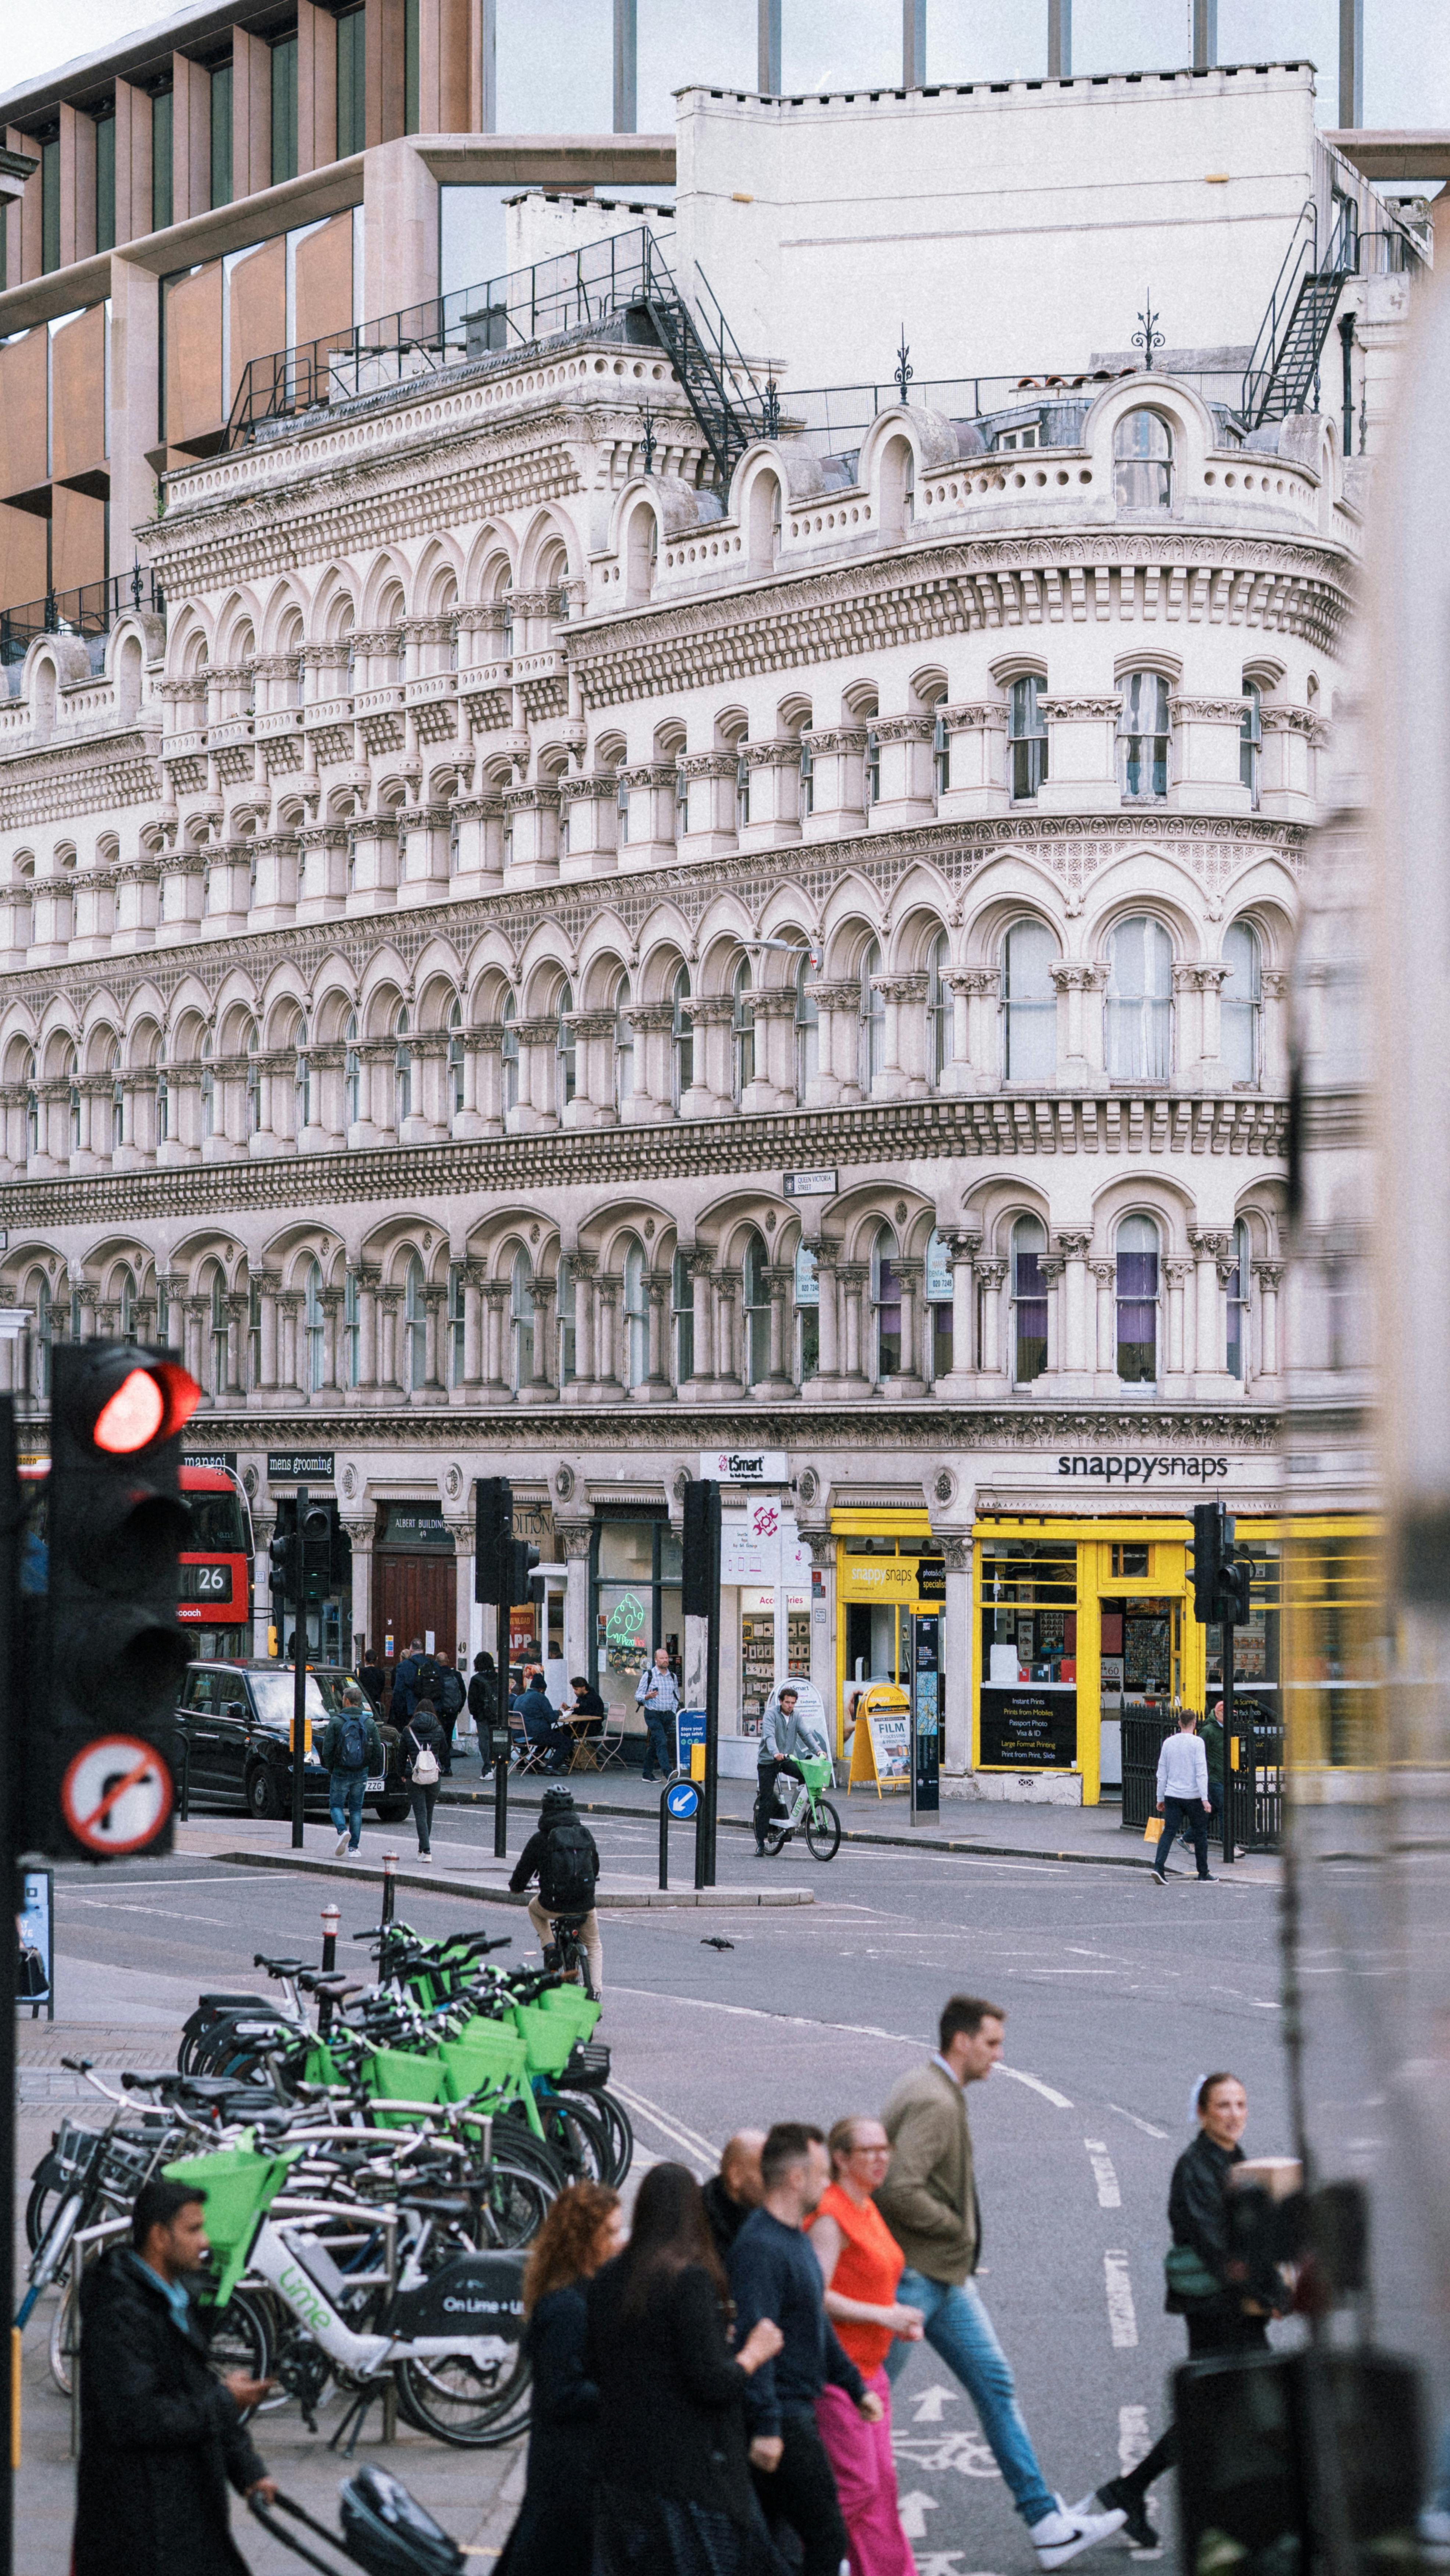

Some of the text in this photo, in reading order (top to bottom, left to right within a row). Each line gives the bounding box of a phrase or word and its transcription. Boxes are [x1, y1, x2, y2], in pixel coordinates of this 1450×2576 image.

[270, 1456, 332, 1473] mens grooming
[1058, 1456, 1228, 1483] snappysnaps
[395, 1518, 446, 1528] ALBERT BUILDING
[199, 1568, 224, 1589] 26
[852, 1568, 911, 1586] snappysnaps
[458, 1642, 467, 1653] 49
[879, 1723, 904, 1733] FILM
[1001, 1740, 1015, 1748] Large
[1036, 1741, 1056, 1750] Printing
[792, 1797, 804, 1817] Lime
[279, 2266, 330, 2330] Lime
[443, 2296, 465, 2312] On
[466, 2297, 499, 2314] Lime
